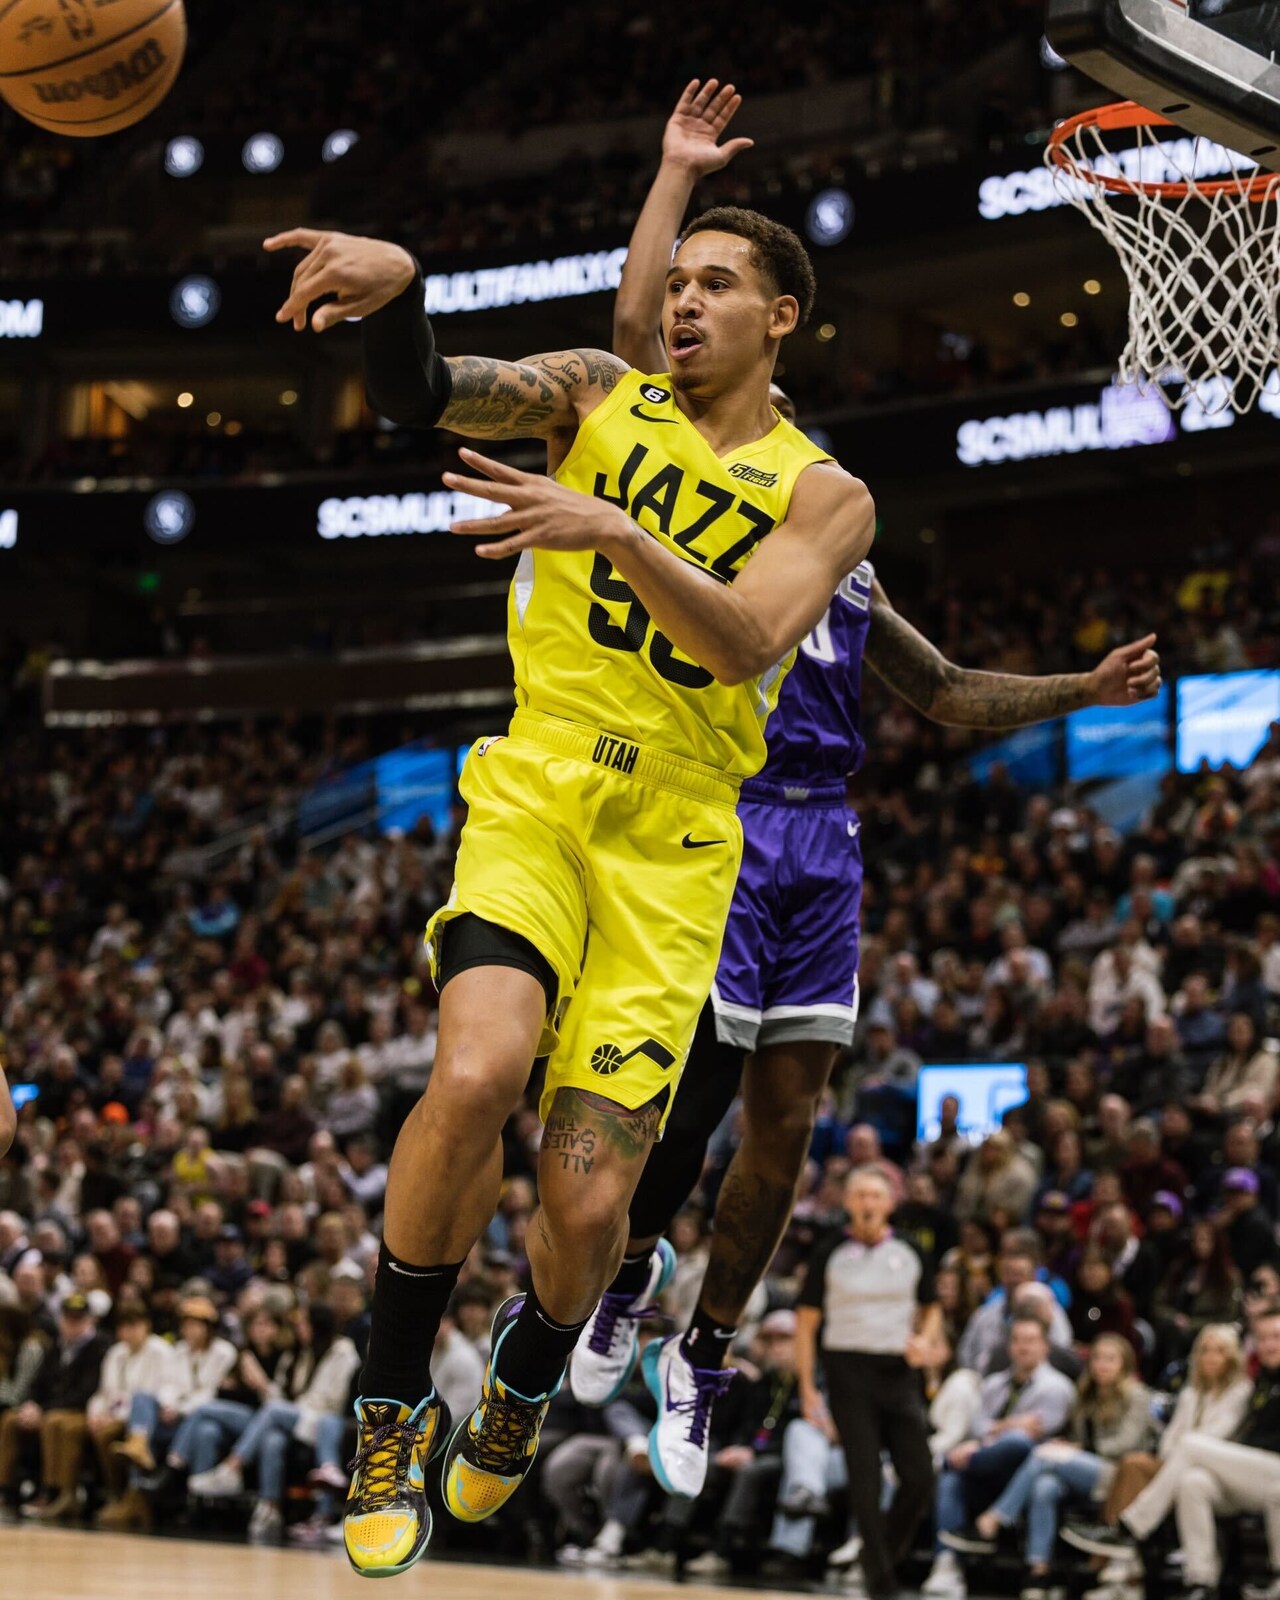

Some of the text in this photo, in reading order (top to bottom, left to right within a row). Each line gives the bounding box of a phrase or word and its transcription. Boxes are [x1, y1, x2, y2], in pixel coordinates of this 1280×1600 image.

[644, 387, 665, 402] 6
[594, 442, 777, 582] JAZZ
[592, 734, 640, 774] UTAH
[543, 1127, 596, 1155] SALES
[558, 1152, 595, 1175] ALL
